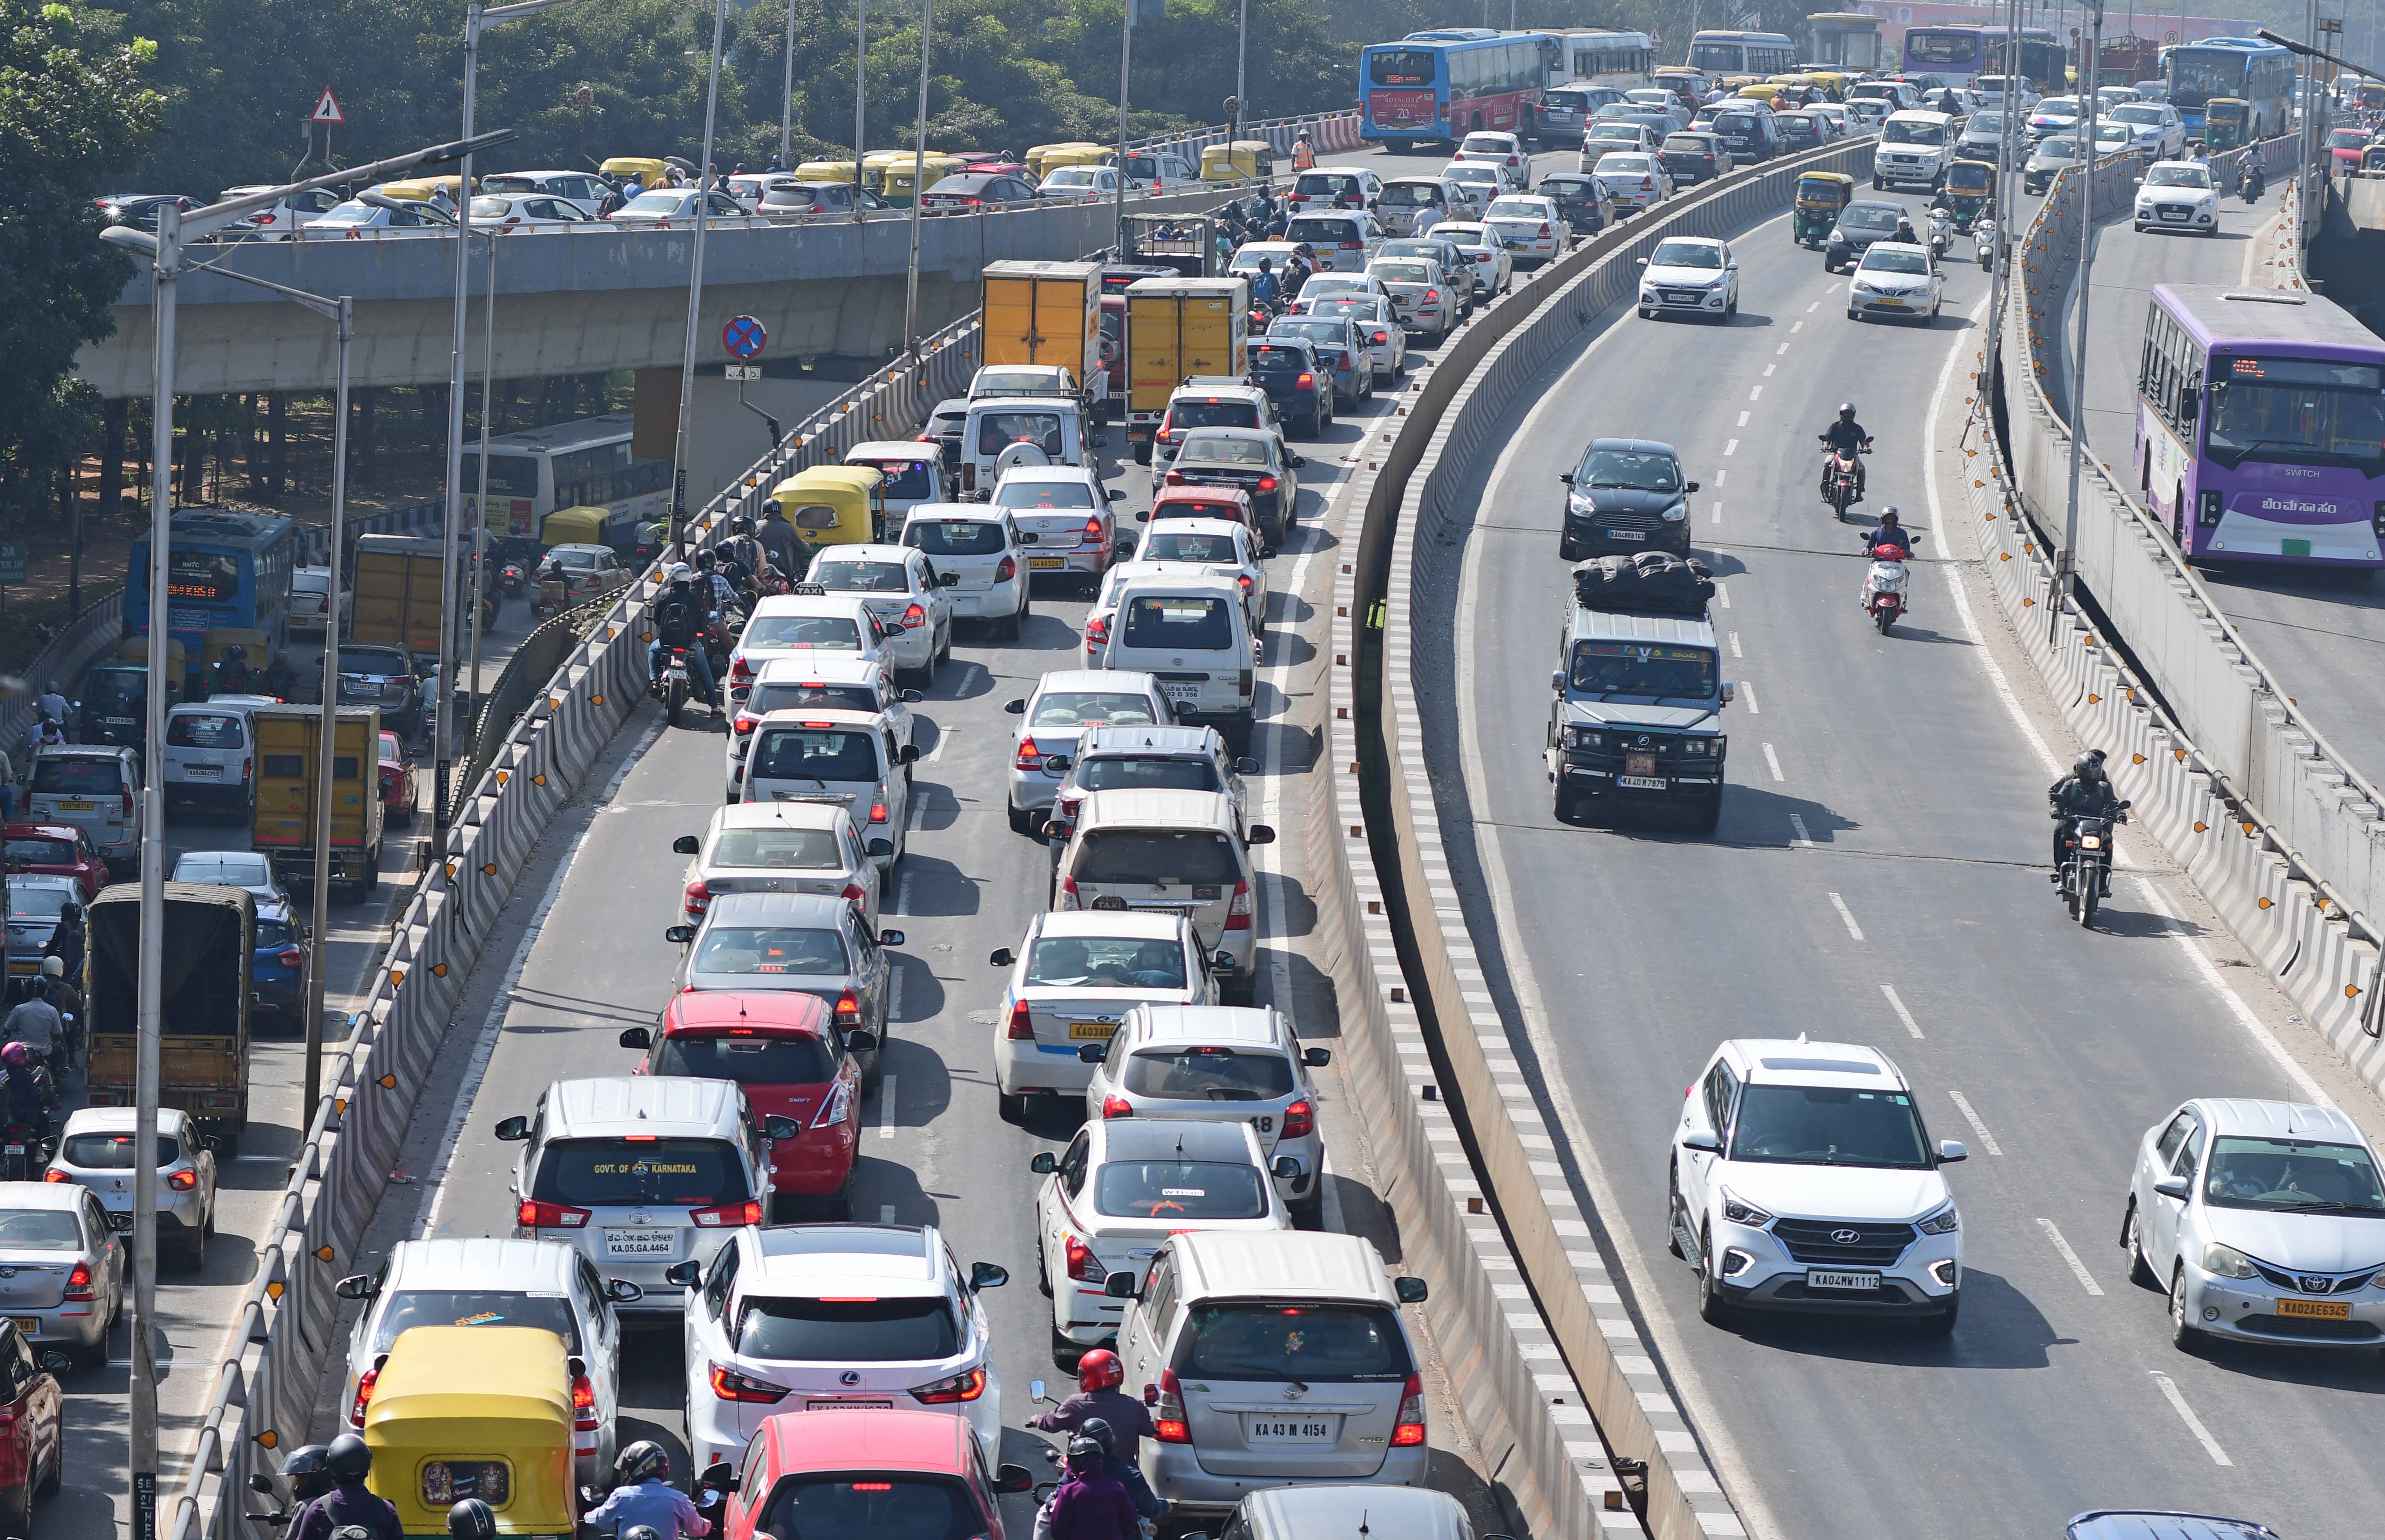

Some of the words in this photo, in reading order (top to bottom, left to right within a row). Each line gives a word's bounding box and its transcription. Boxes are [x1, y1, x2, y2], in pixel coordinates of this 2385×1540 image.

[2285, 469, 2320, 478] SWITCH
[594, 1164, 616, 1174] GOVT.
[619, 1165, 629, 1174] OF
[651, 1164, 696, 1174] KARNATAKA
[1815, 1275, 1879, 1288] KA04MW1112
[2285, 1303, 2347, 1316] KA02AE6345
[1256, 1424, 1269, 1436] KA
[1273, 1424, 1285, 1436] 43
[1289, 1424, 1297, 1436] M
[1302, 1424, 1326, 1437] 4154
[138, 1478, 151, 1489] SE
